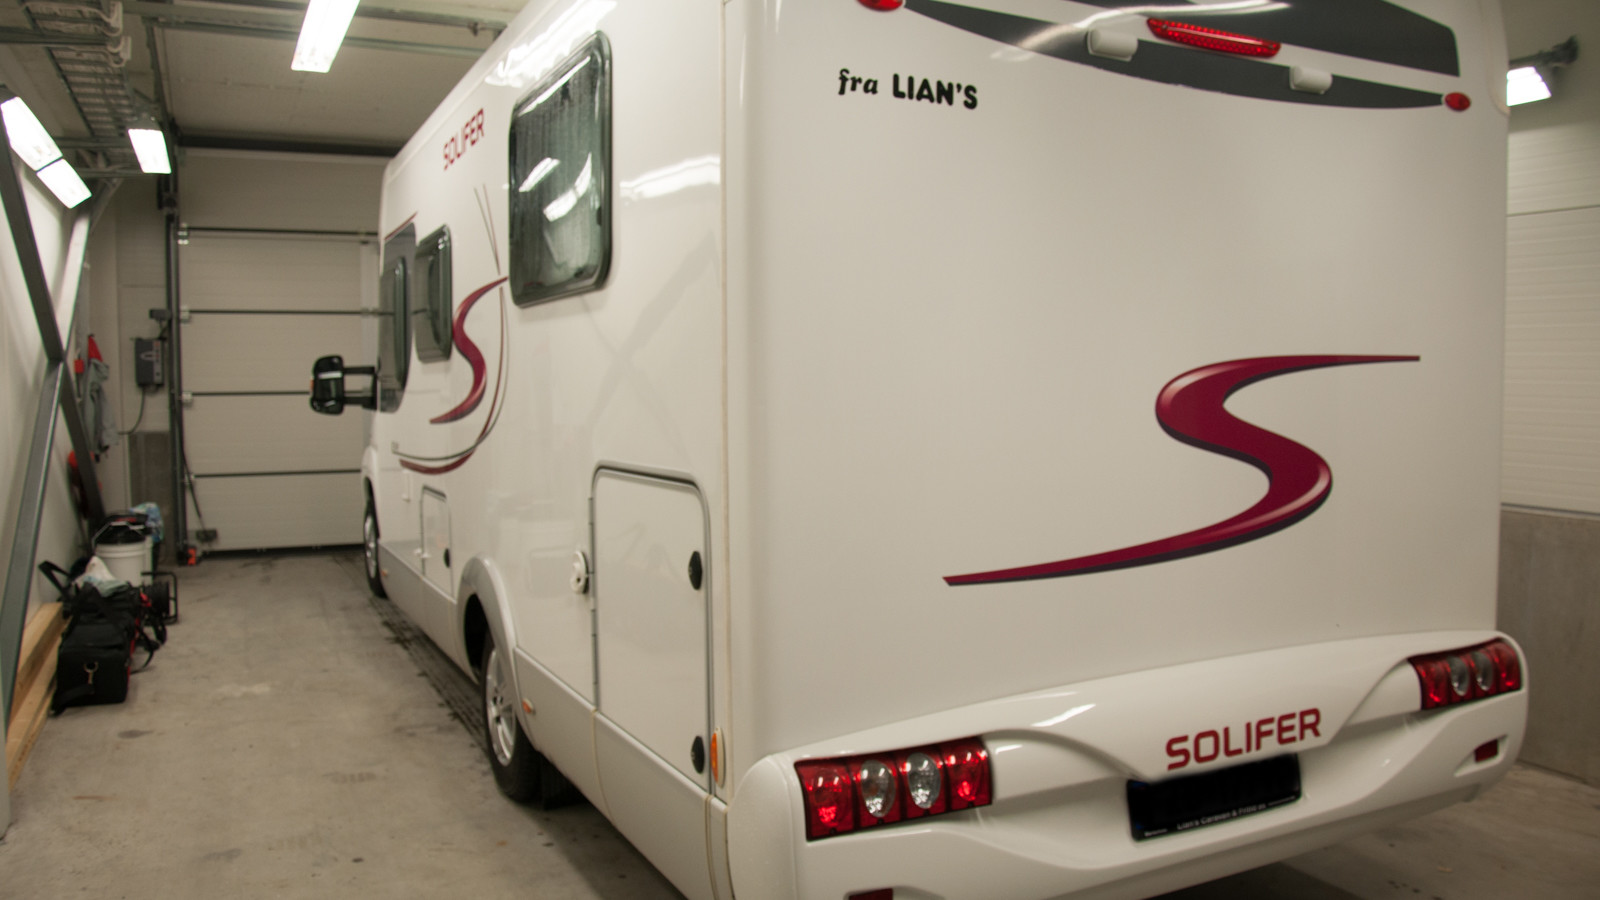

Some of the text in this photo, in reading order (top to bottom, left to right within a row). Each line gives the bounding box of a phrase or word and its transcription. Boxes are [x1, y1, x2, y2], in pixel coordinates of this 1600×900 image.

[838, 68, 978, 110] fra LIAN'S
[443, 107, 485, 171] SOLIFER
[1165, 707, 1321, 771] SOLIFER
